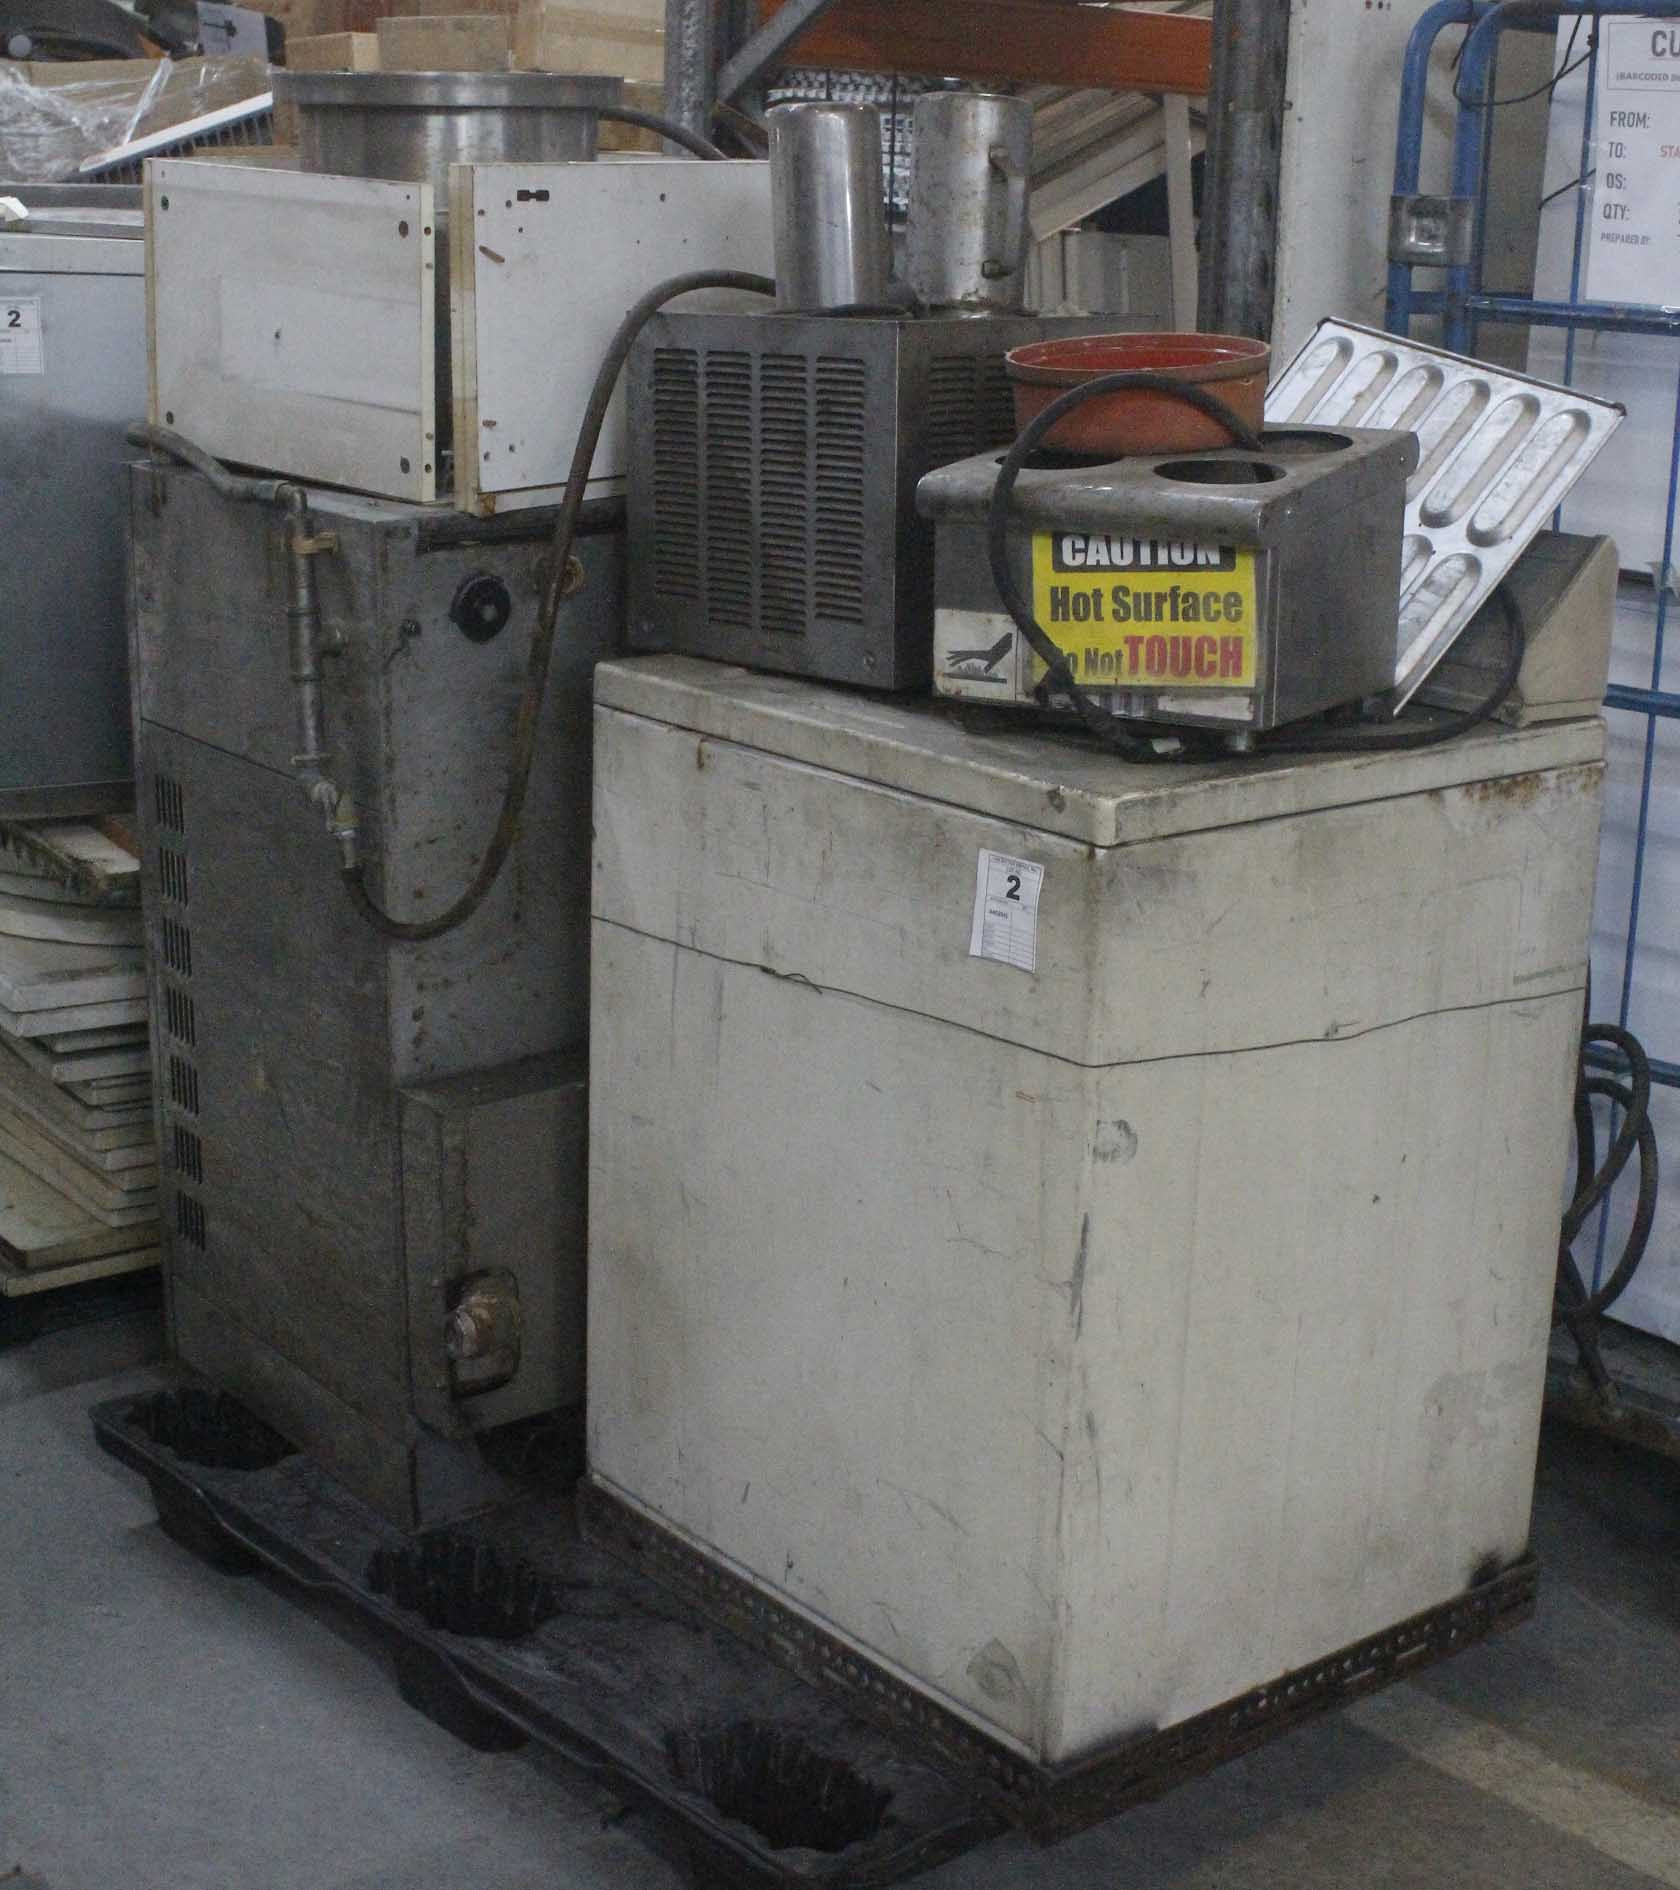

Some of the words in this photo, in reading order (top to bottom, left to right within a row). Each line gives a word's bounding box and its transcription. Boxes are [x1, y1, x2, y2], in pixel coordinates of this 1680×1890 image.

[1609, 110, 1651, 128] FROM:
[1608, 141, 1627, 159] TO:
[1606, 172, 1627, 190] OS:
[1603, 203, 1630, 221] QTY:
[8, 309, 21, 328] 2
[1062, 534, 1220, 566] CAUTION
[1050, 586, 1104, 622] Hot
[1111, 585, 1243, 622] Surface
[1084, 648, 1124, 678] Not
[1124, 635, 1243, 678] TOUCH
[1006, 875, 1021, 901] 2
